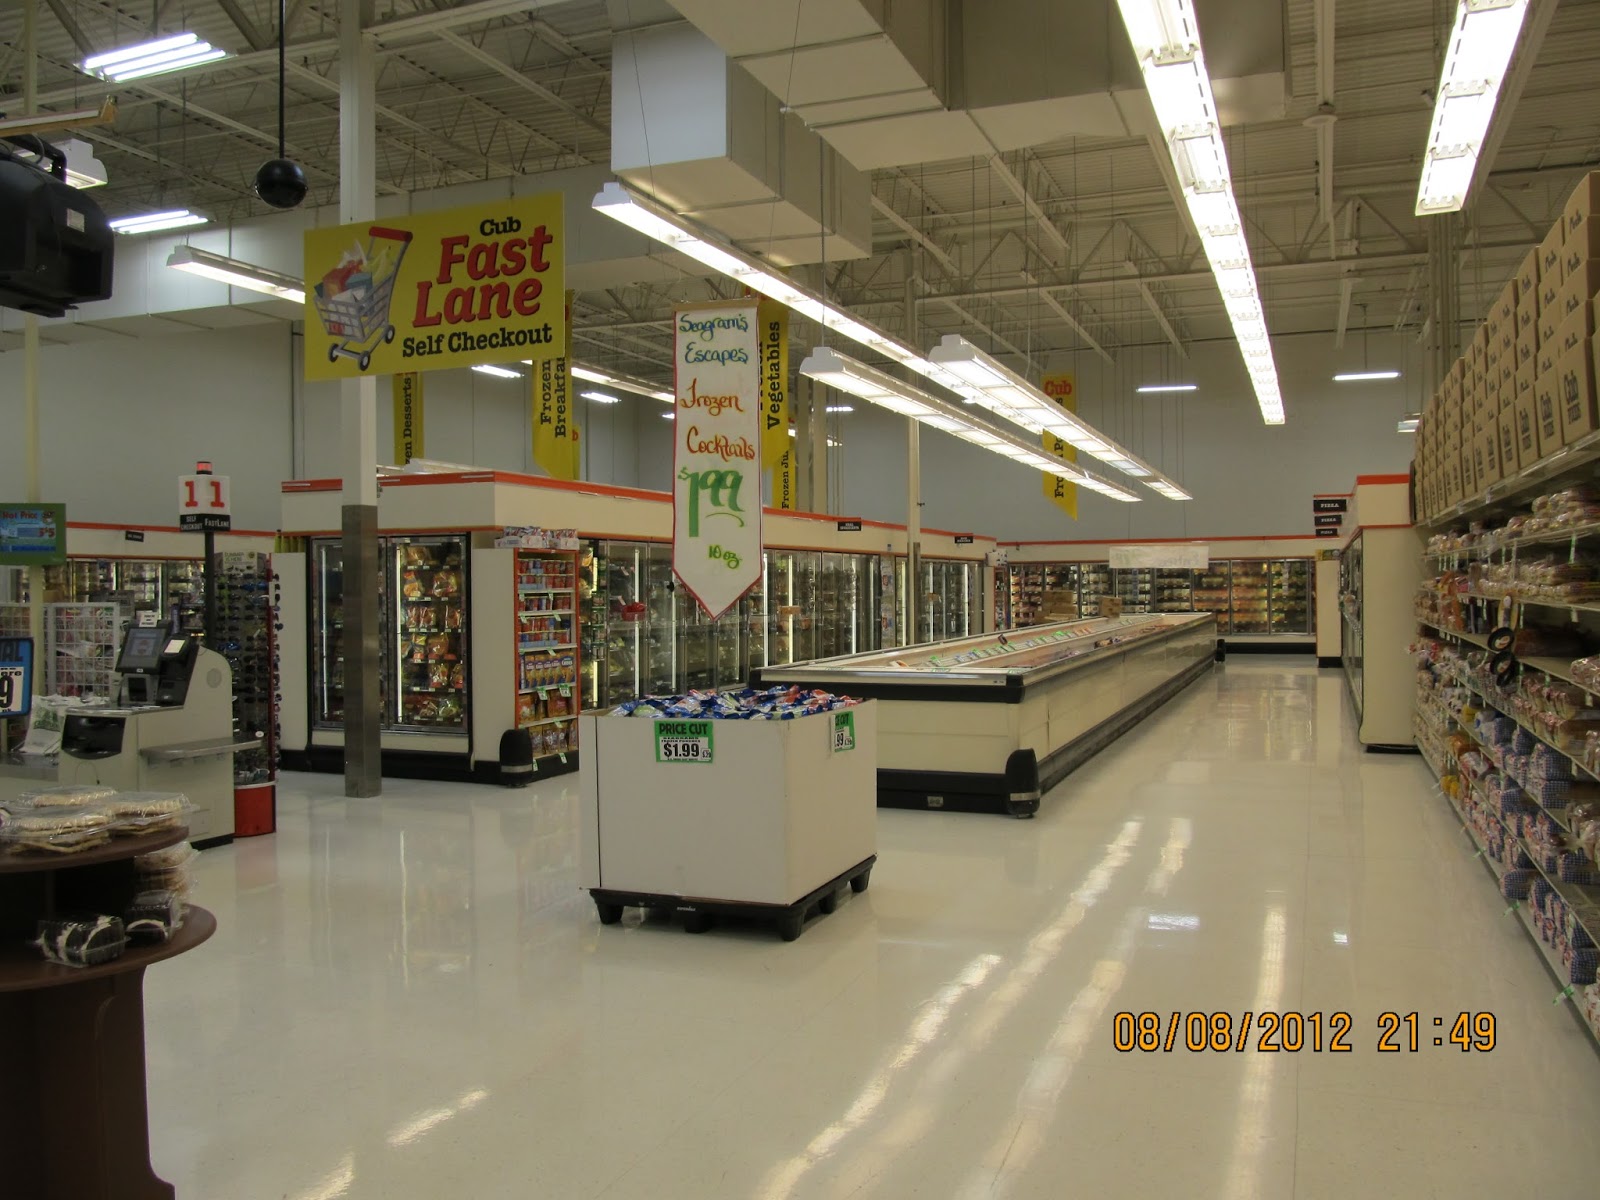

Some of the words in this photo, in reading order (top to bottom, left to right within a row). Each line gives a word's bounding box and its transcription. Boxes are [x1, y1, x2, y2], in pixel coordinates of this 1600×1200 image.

[480, 216, 522, 237] Cub
[437, 225, 553, 285] Fast
[412, 277, 543, 328] Lane
[402, 333, 445, 358] Self
[447, 323, 553, 353] Checkout
[679, 313, 749, 342] Seagram's
[684, 341, 749, 367] Escapes
[540, 359, 552, 425] Frozen
[767, 321, 784, 430] Vegetables
[1044, 380, 1073, 396] Cub
[403, 377, 413, 439] Desserts
[680, 377, 744, 417] Frozen
[686, 425, 756, 463] Cocktails
[781, 475, 790, 509] Frozen
[708, 544, 722, 560] 10
[658, 723, 687, 735] PRICE
[689, 723, 708, 735] CUT
[664, 742, 700, 760] $1.99
